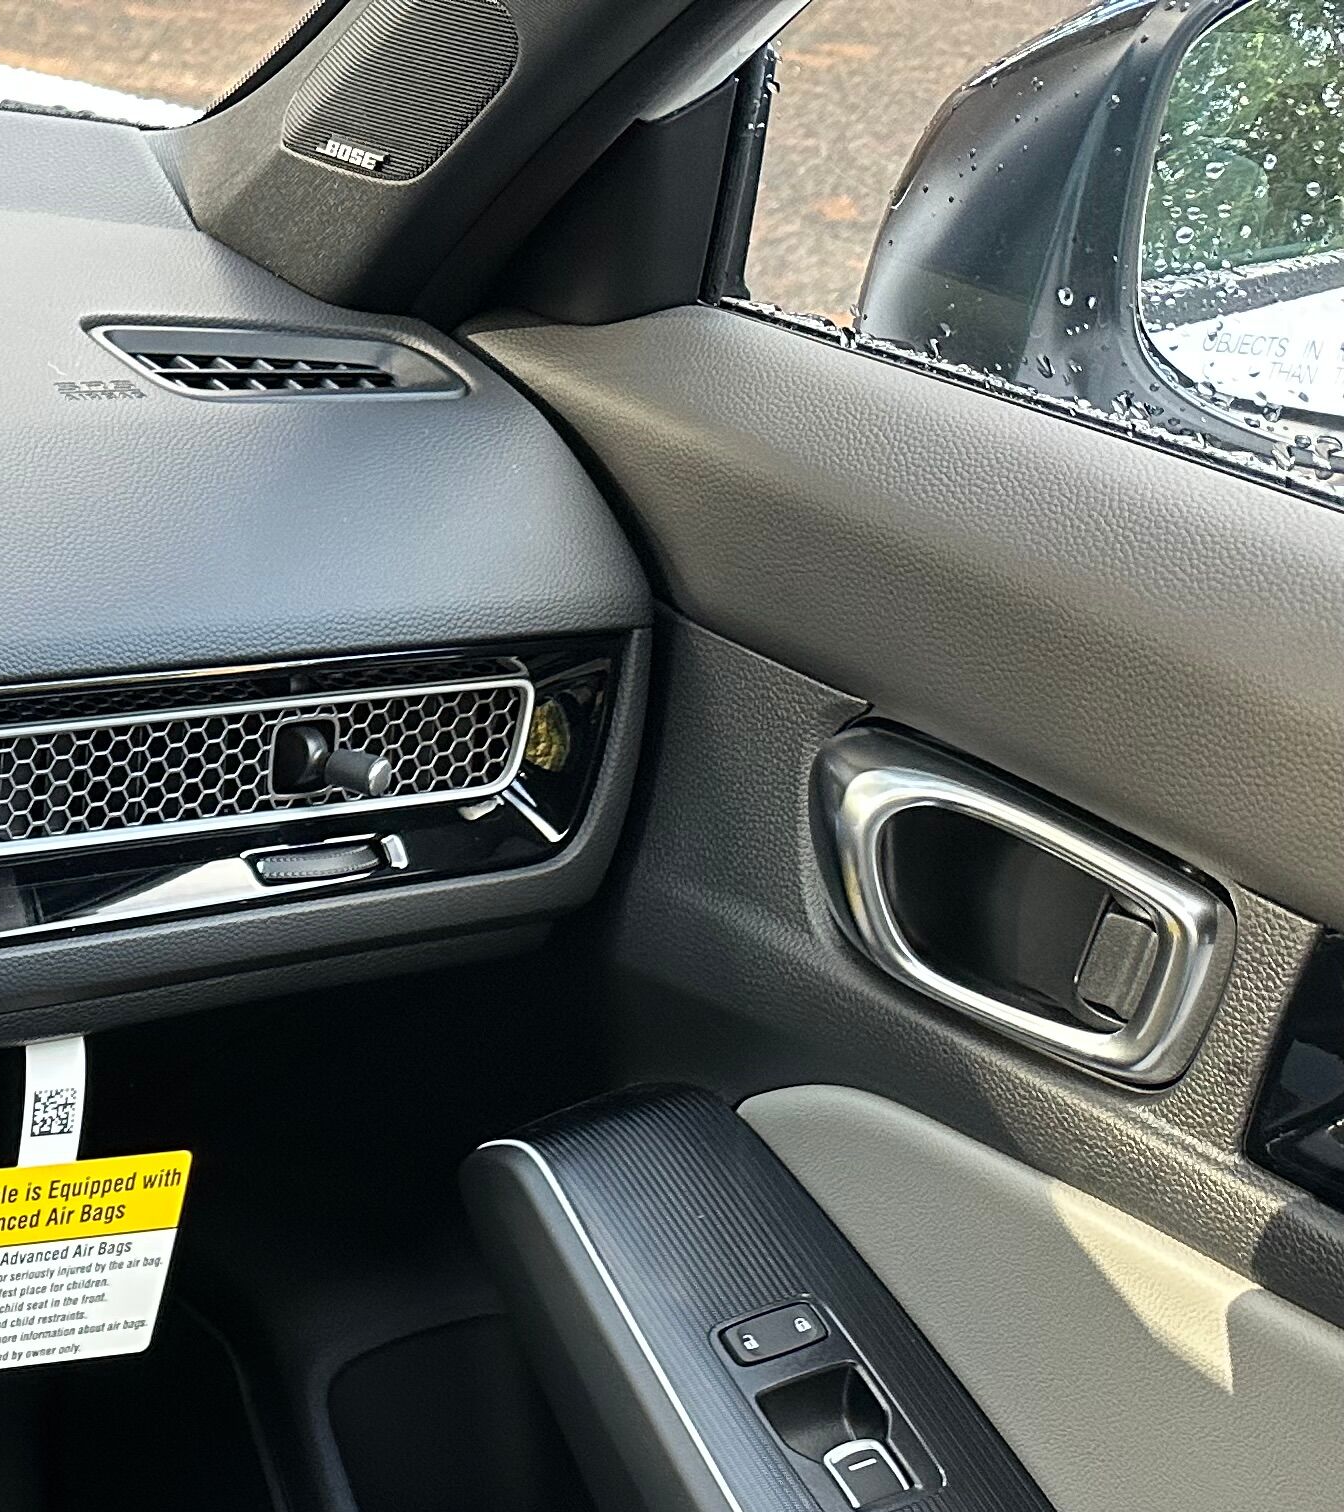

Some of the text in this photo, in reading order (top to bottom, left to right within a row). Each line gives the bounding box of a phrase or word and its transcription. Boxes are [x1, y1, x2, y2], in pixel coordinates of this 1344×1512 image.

[315, 140, 385, 171] BOSE
[1203, 333, 1289, 358] OBJECTS
[25, 1182, 41, 1201] is
[48, 1172, 137, 1201] Equipped
[142, 1168, 182, 1189] with
[46, 1206, 73, 1226] Air
[80, 1203, 126, 1224] Bags
[0, 1246, 70, 1266] Advanced
[72, 1244, 94, 1259] Air
[98, 1241, 133, 1257] Bags
[9, 1268, 55, 1282] seriously
[57, 1263, 92, 1278] injured
[95, 1262, 106, 1273] by
[109, 1260, 124, 1271] the
[126, 1258, 140, 1269] air
[19, 1285, 47, 1298] place
[50, 1282, 64, 1293] for
[0, 1301, 24, 1313] child
[26, 1299, 48, 1310] seat
[50, 1298, 60, 1308] in
[63, 1296, 78, 1306] the
[10, 1315, 35, 1328] child
[20, 1327, 75, 1341] information
[78, 1322, 106, 1335] about
[107, 1321, 119, 1331] air
[11, 1350, 23, 1362] by
[25, 1348, 56, 1359] owner
